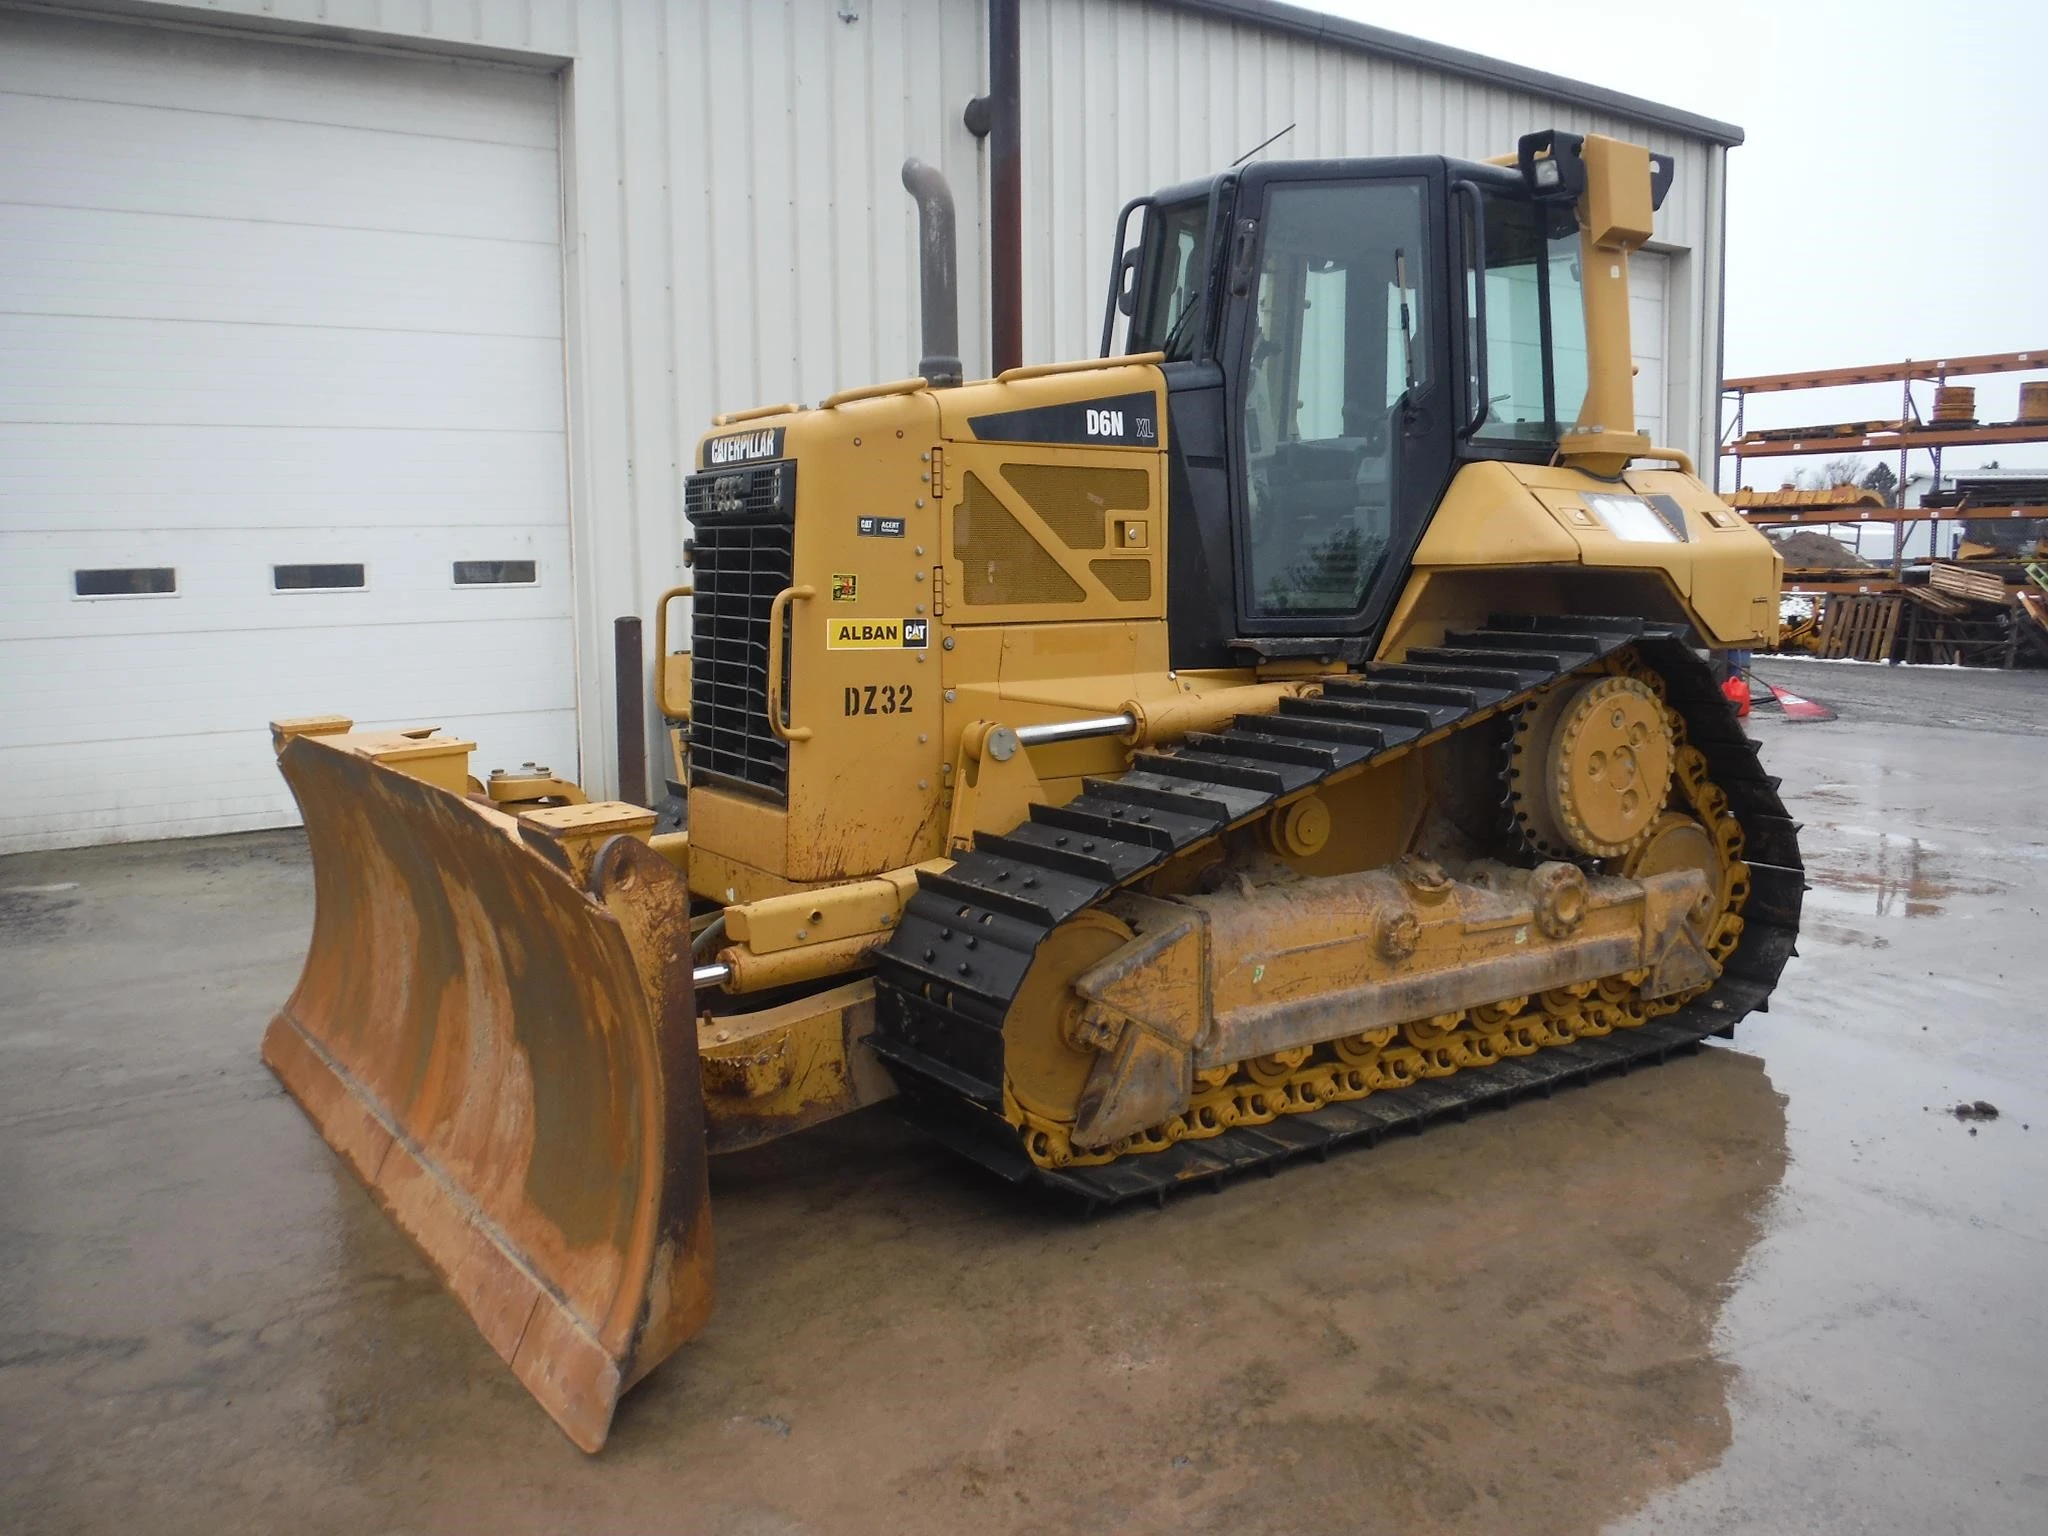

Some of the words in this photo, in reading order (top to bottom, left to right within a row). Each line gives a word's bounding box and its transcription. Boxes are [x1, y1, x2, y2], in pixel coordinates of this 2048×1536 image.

[1086, 409, 1124, 436] D6N
[1136, 418, 1154, 438] XL
[711, 429, 775, 463] CATERPILLAR
[860, 519, 872, 528] CAT
[839, 626, 898, 640] ALBAN
[905, 624, 926, 640] CAT
[845, 684, 913, 717] DZ32
